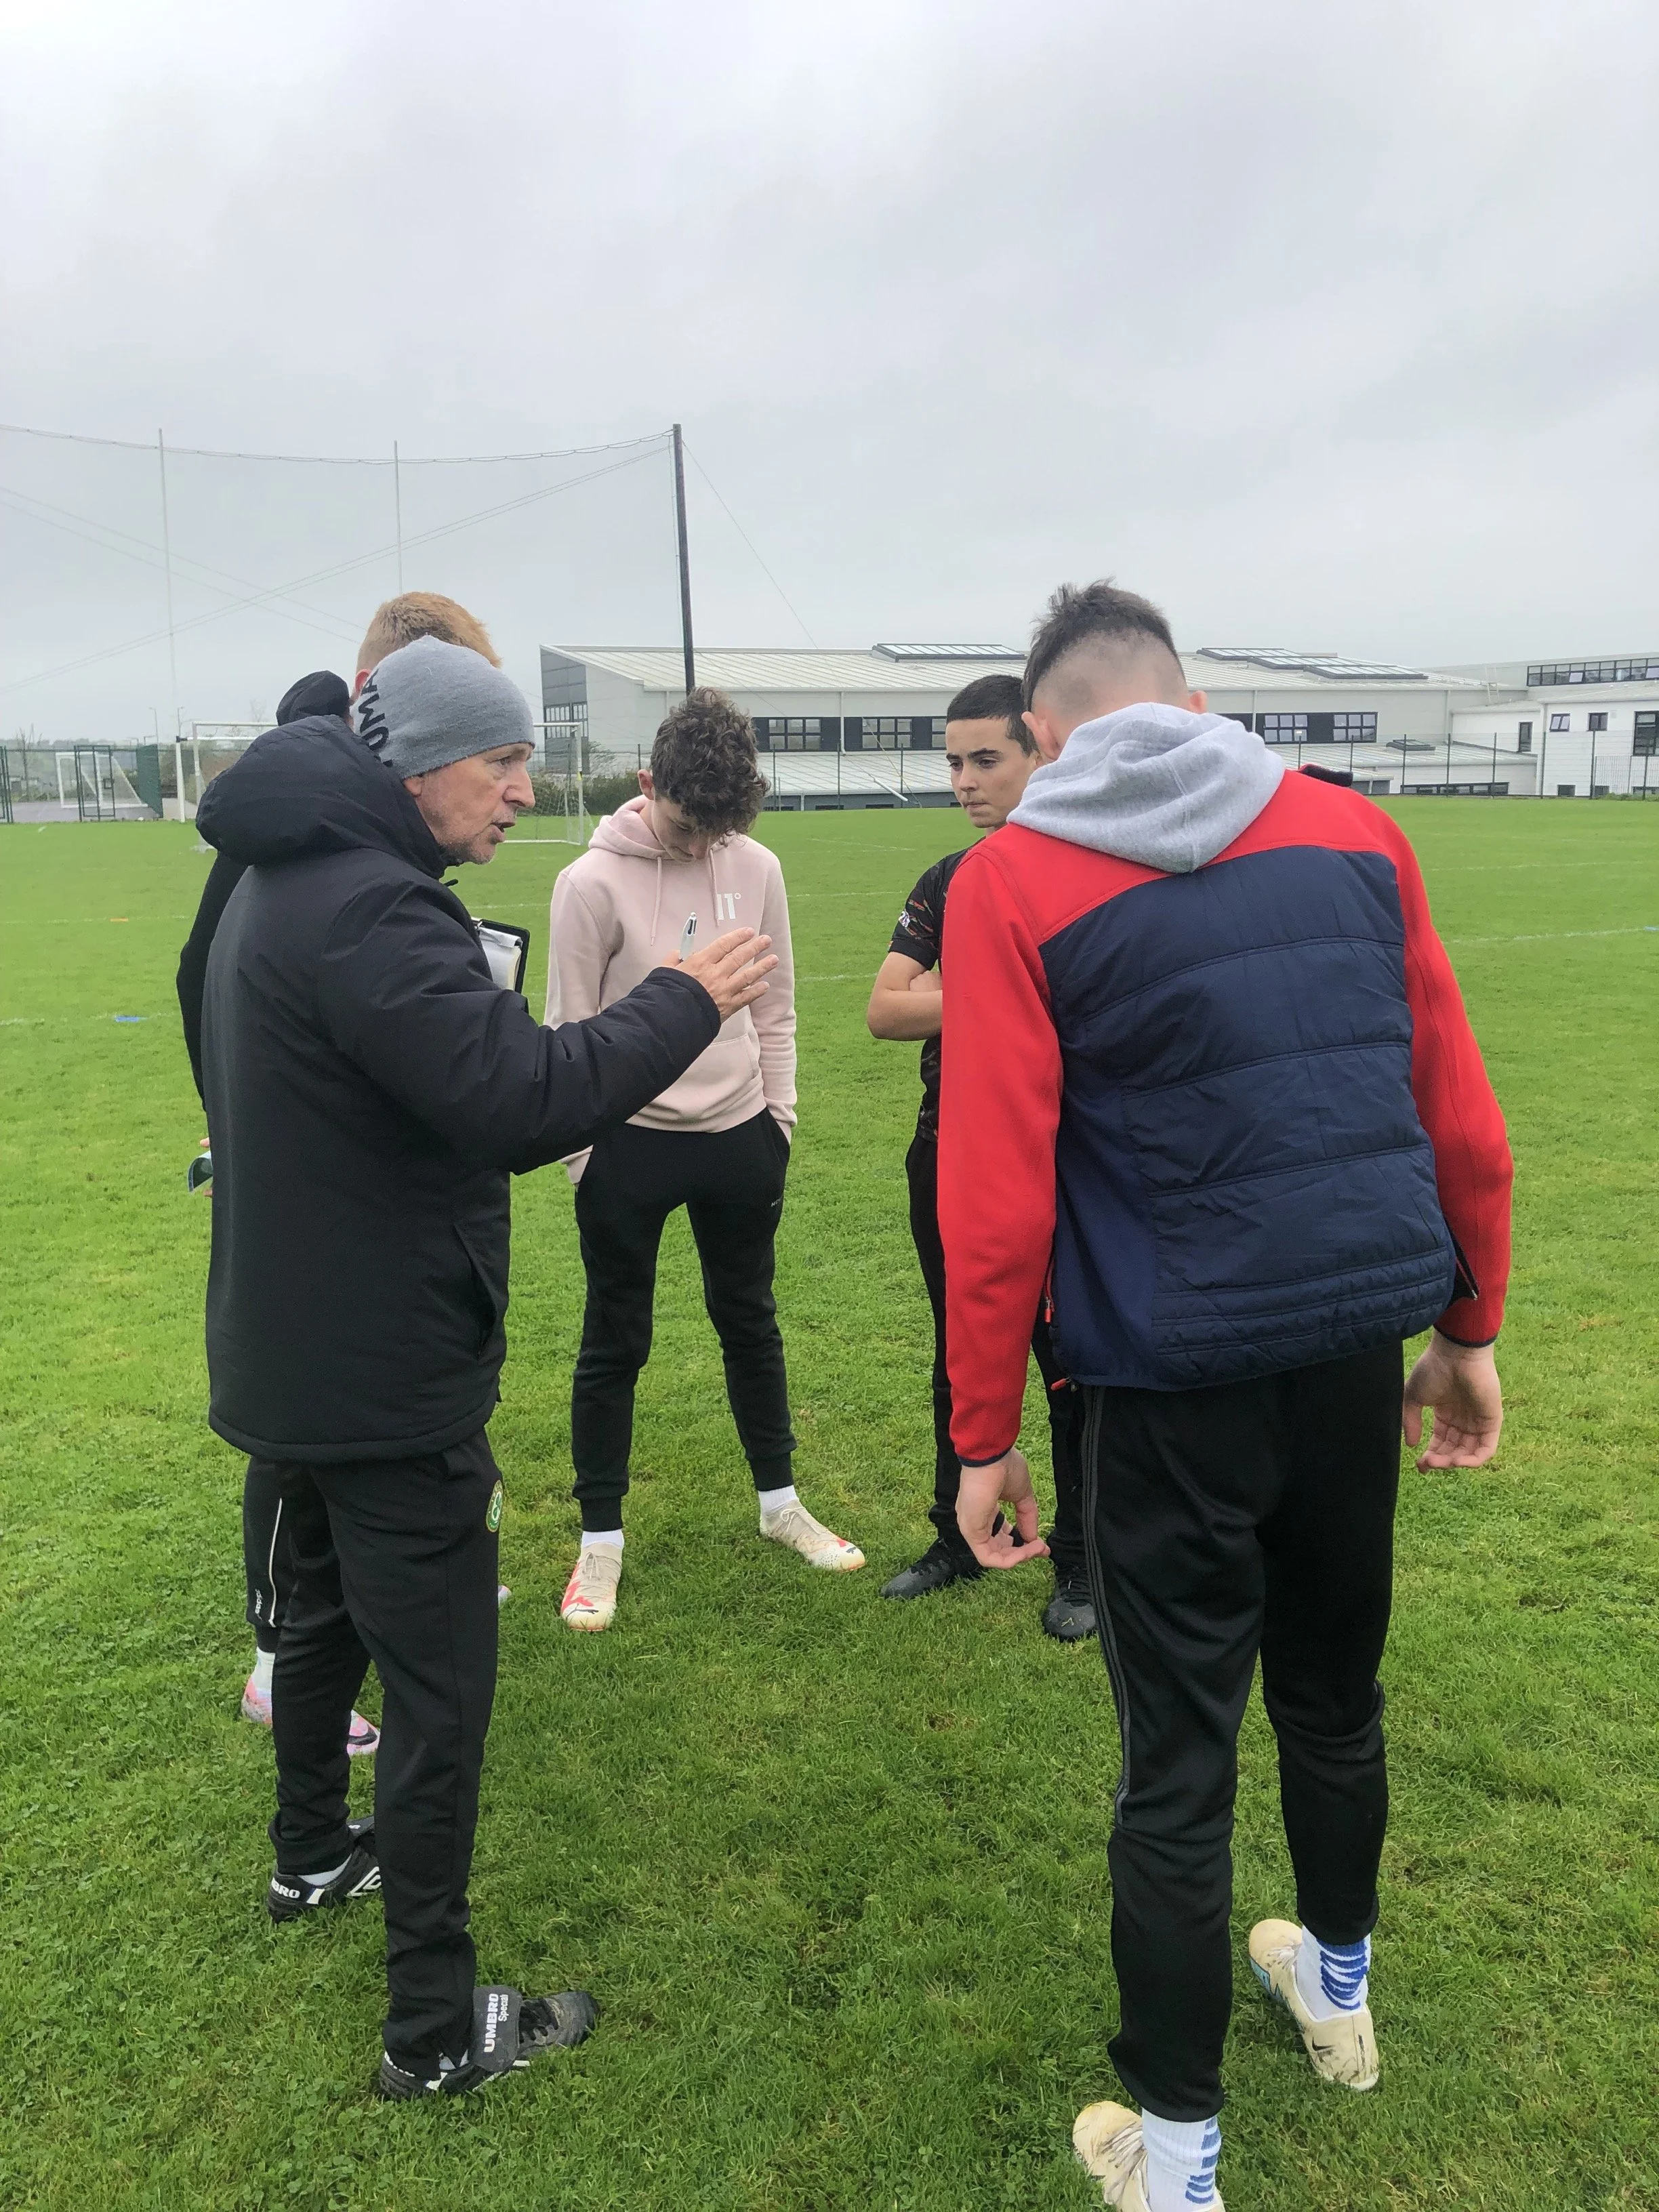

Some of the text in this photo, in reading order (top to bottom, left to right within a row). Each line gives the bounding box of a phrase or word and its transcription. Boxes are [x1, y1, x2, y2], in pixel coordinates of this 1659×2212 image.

[358, 668, 393, 767] UMA
[271, 1877, 301, 1899] BRO
[484, 1993, 499, 2053] UMBRO
[498, 1994, 509, 2022] Special
